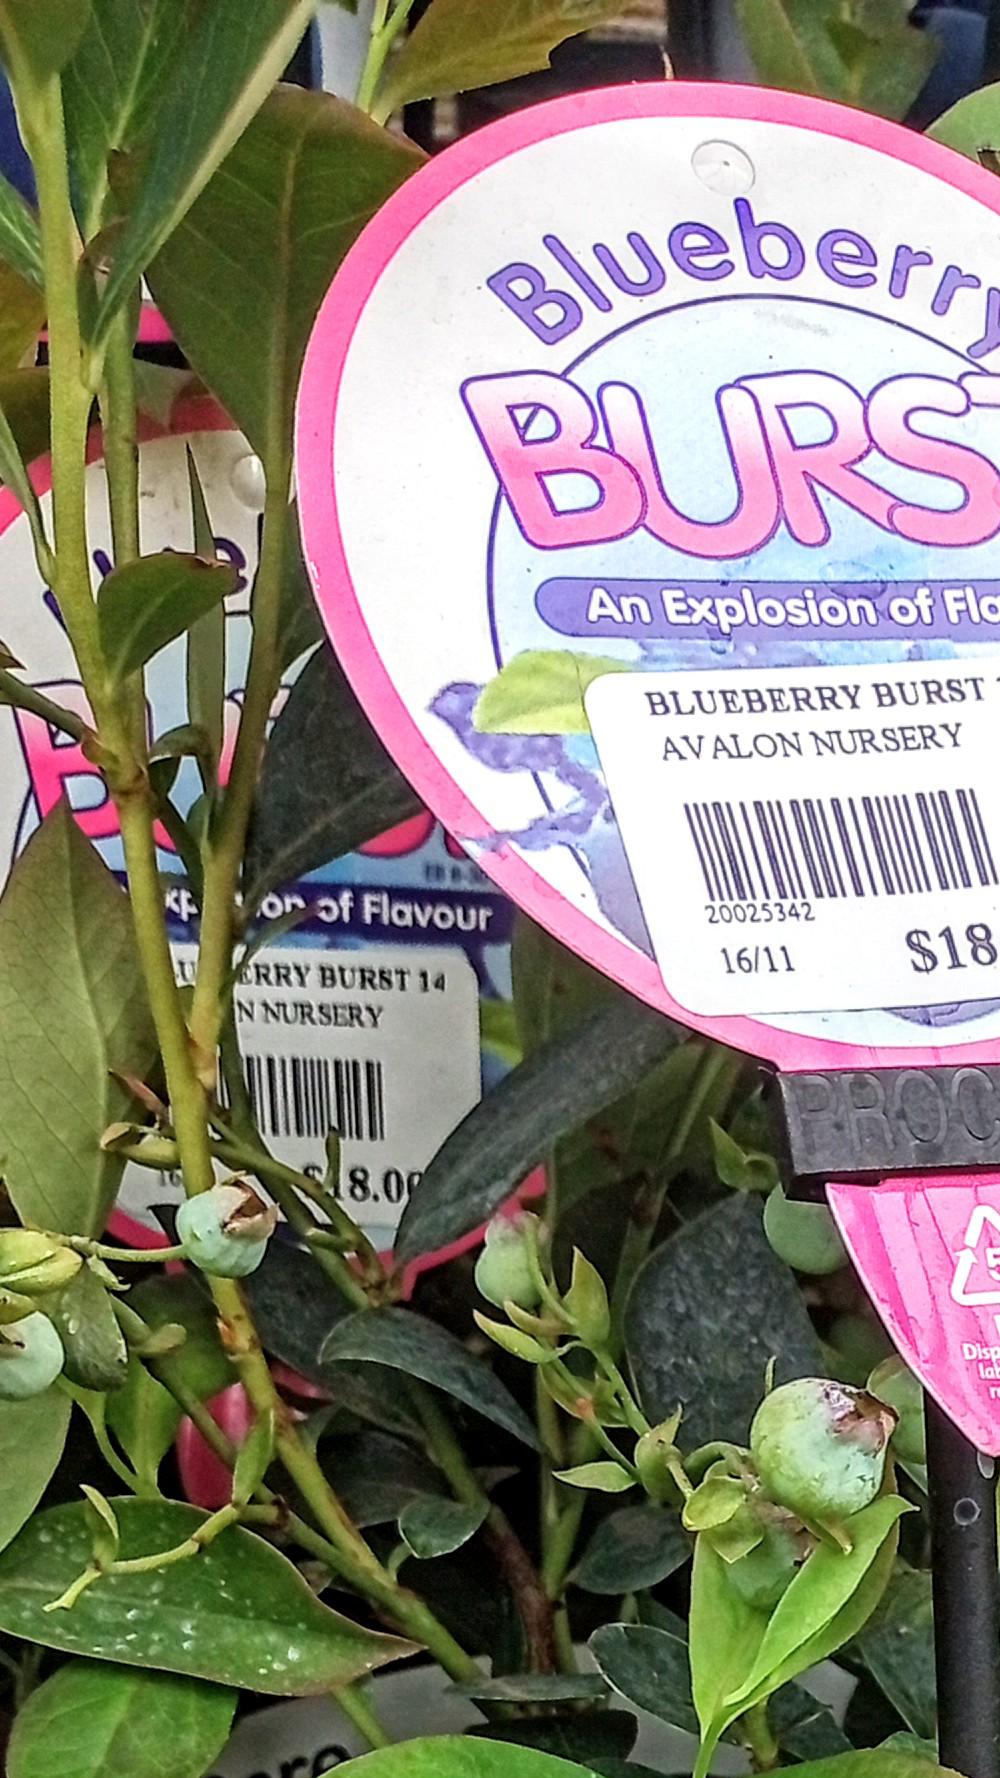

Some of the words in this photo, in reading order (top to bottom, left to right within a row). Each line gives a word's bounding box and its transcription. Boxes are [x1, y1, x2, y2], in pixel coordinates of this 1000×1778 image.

[587, 588, 652, 625] An
[663, 588, 878, 635] Explosion
[889, 590, 935, 626] of
[645, 684, 861, 717] BLUEBERRY
[871, 677, 985, 708] BURST
[662, 731, 804, 762] AVALON
[809, 722, 963, 757] NURSERY
[363, 890, 493, 932] Flavour
[704, 902, 816, 925] 20025342
[720, 945, 796, 976] 16/11
[319, 964, 410, 992] BURST
[420, 969, 446, 993] 14
[261, 1001, 384, 1030] NURSERY
